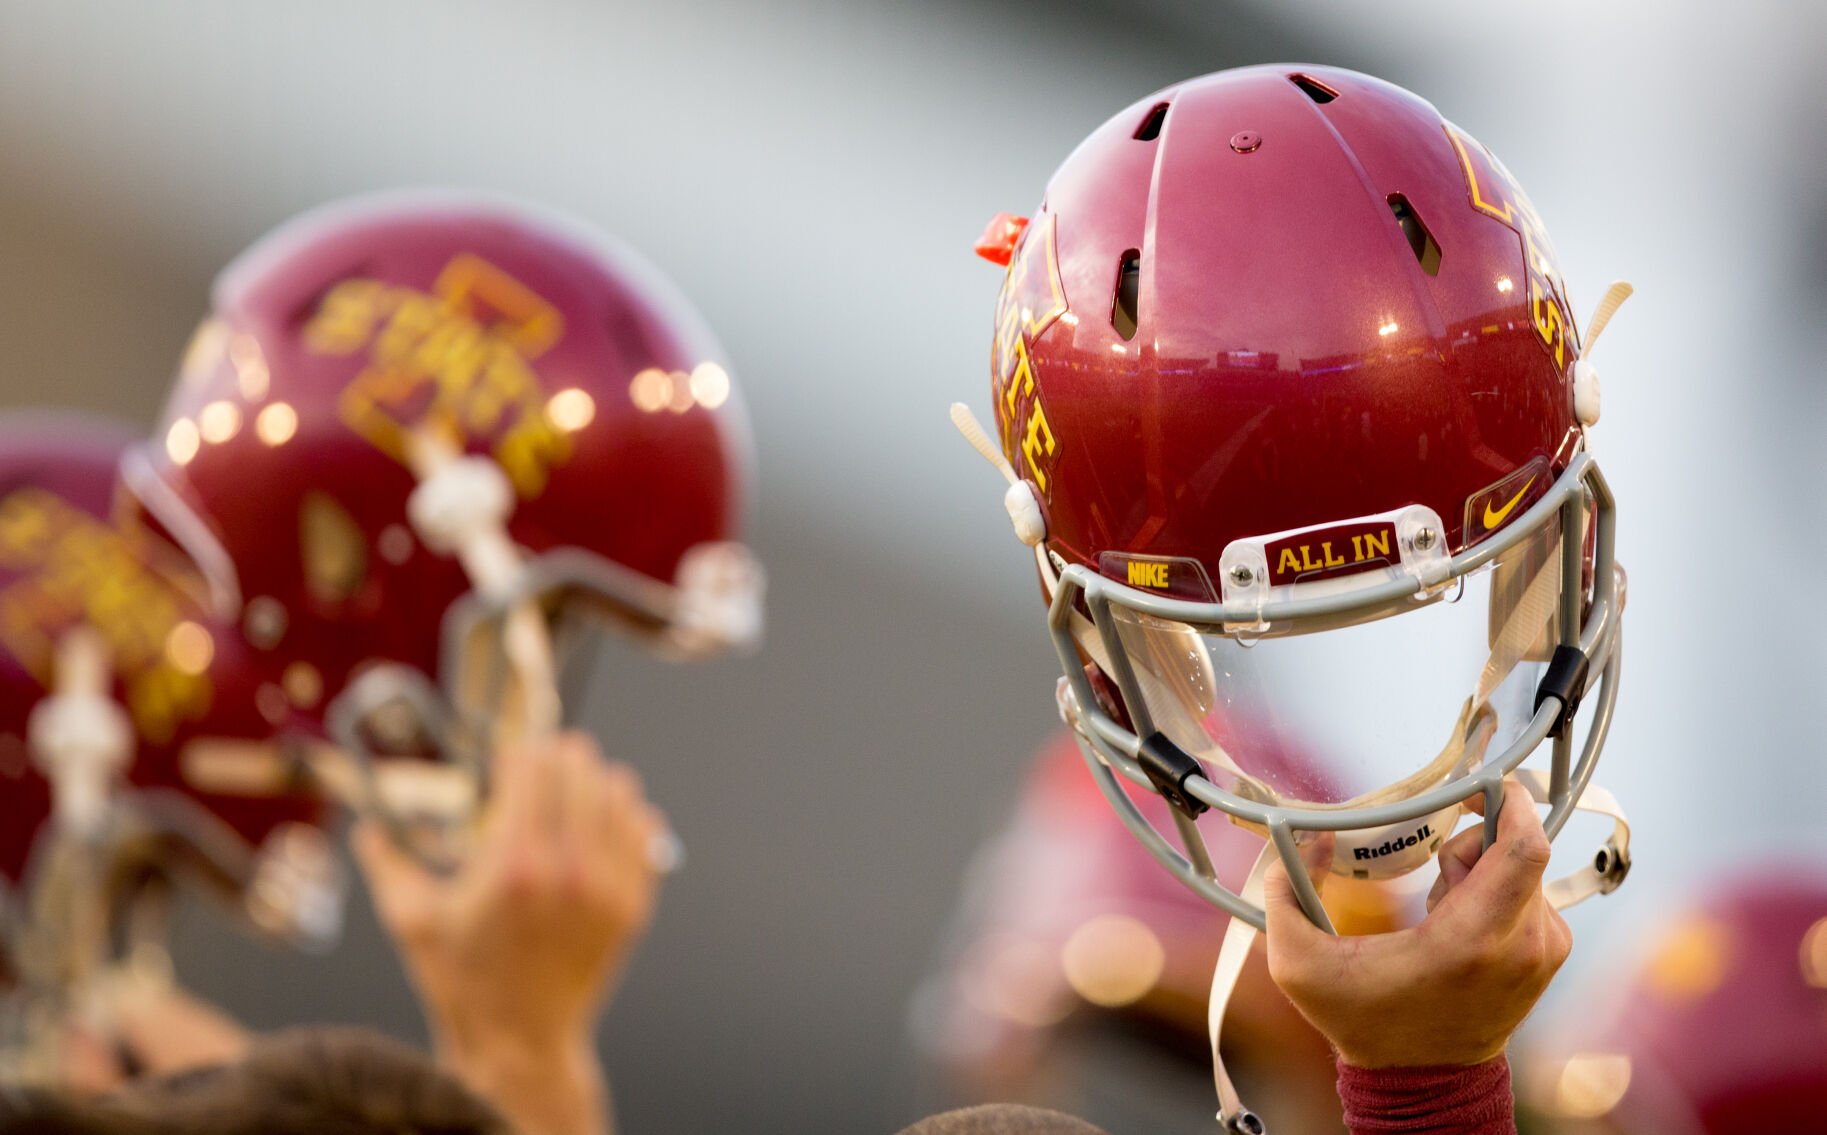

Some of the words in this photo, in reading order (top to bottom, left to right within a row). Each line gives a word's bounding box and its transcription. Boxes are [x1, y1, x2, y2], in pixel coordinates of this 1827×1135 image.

[1276, 541, 1345, 575] ALL
[1351, 529, 1390, 561] IN
[1127, 561, 1169, 588] NIKE
[1353, 824, 1432, 860] Riddell
